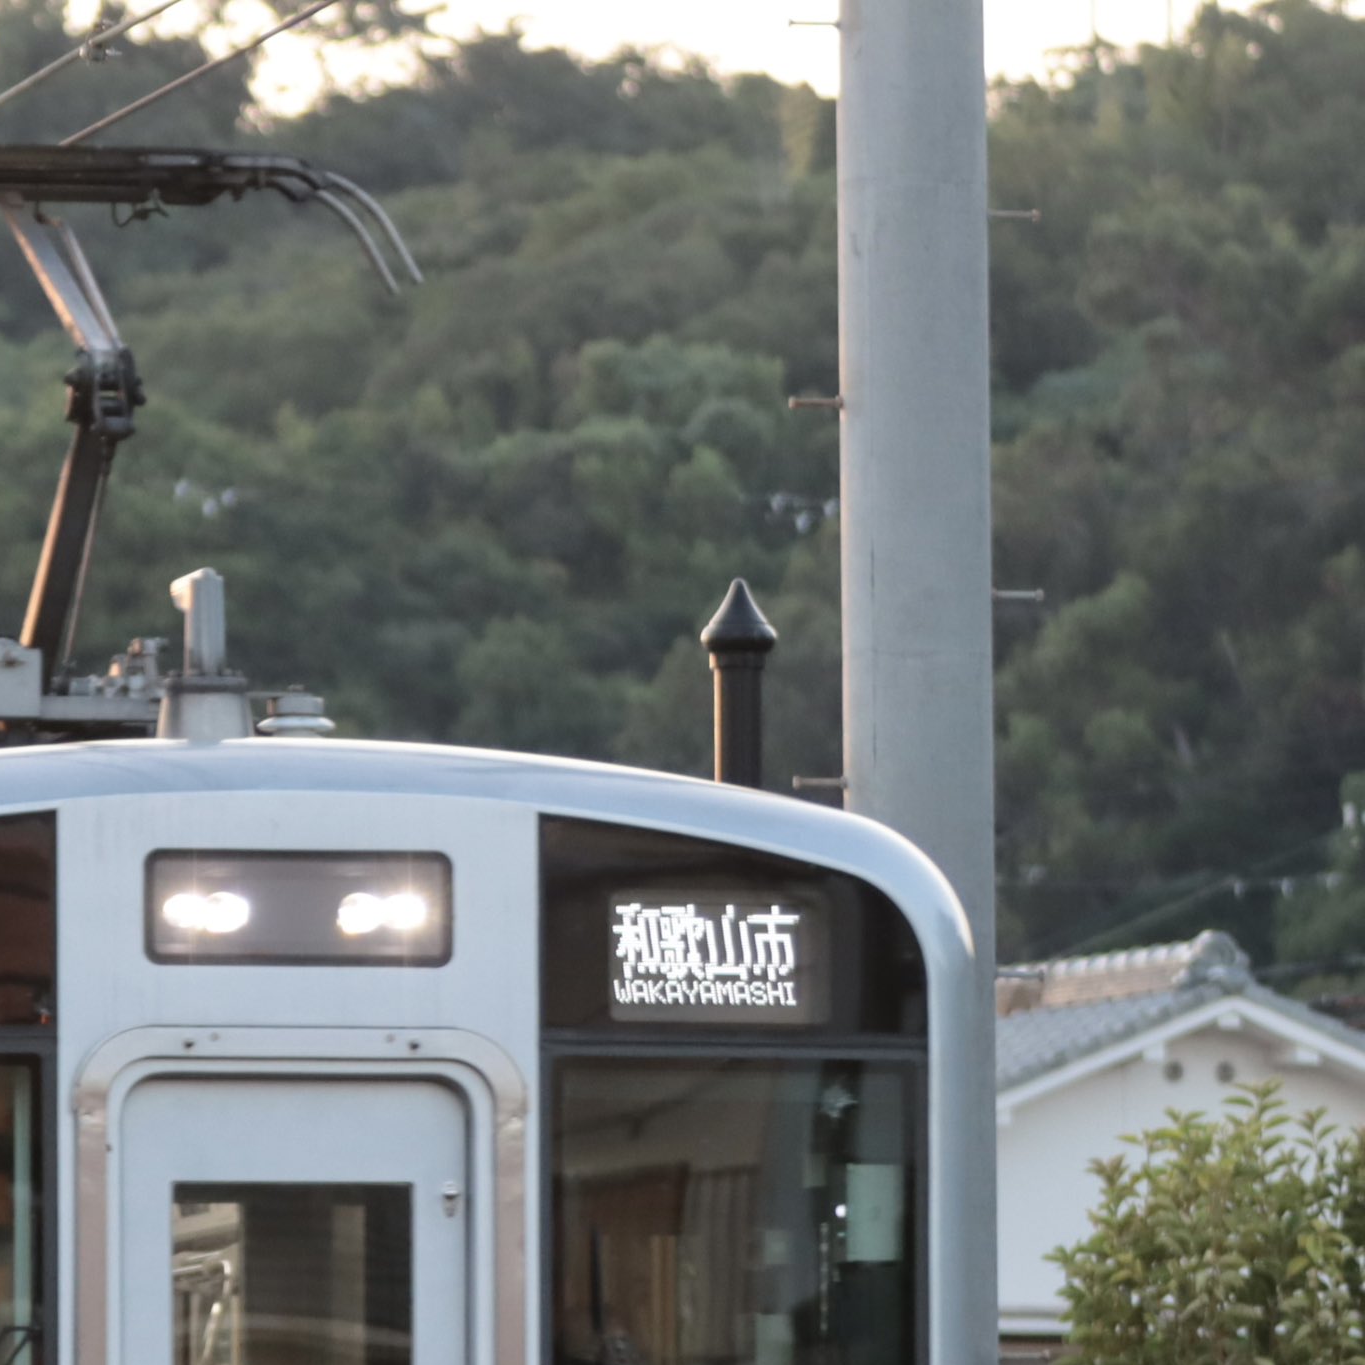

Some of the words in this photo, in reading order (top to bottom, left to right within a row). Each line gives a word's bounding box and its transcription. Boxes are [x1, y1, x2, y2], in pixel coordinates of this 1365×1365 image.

[612, 903, 800, 982] 和歌山市
[613, 979, 797, 1005] WAKAYAMASHI
